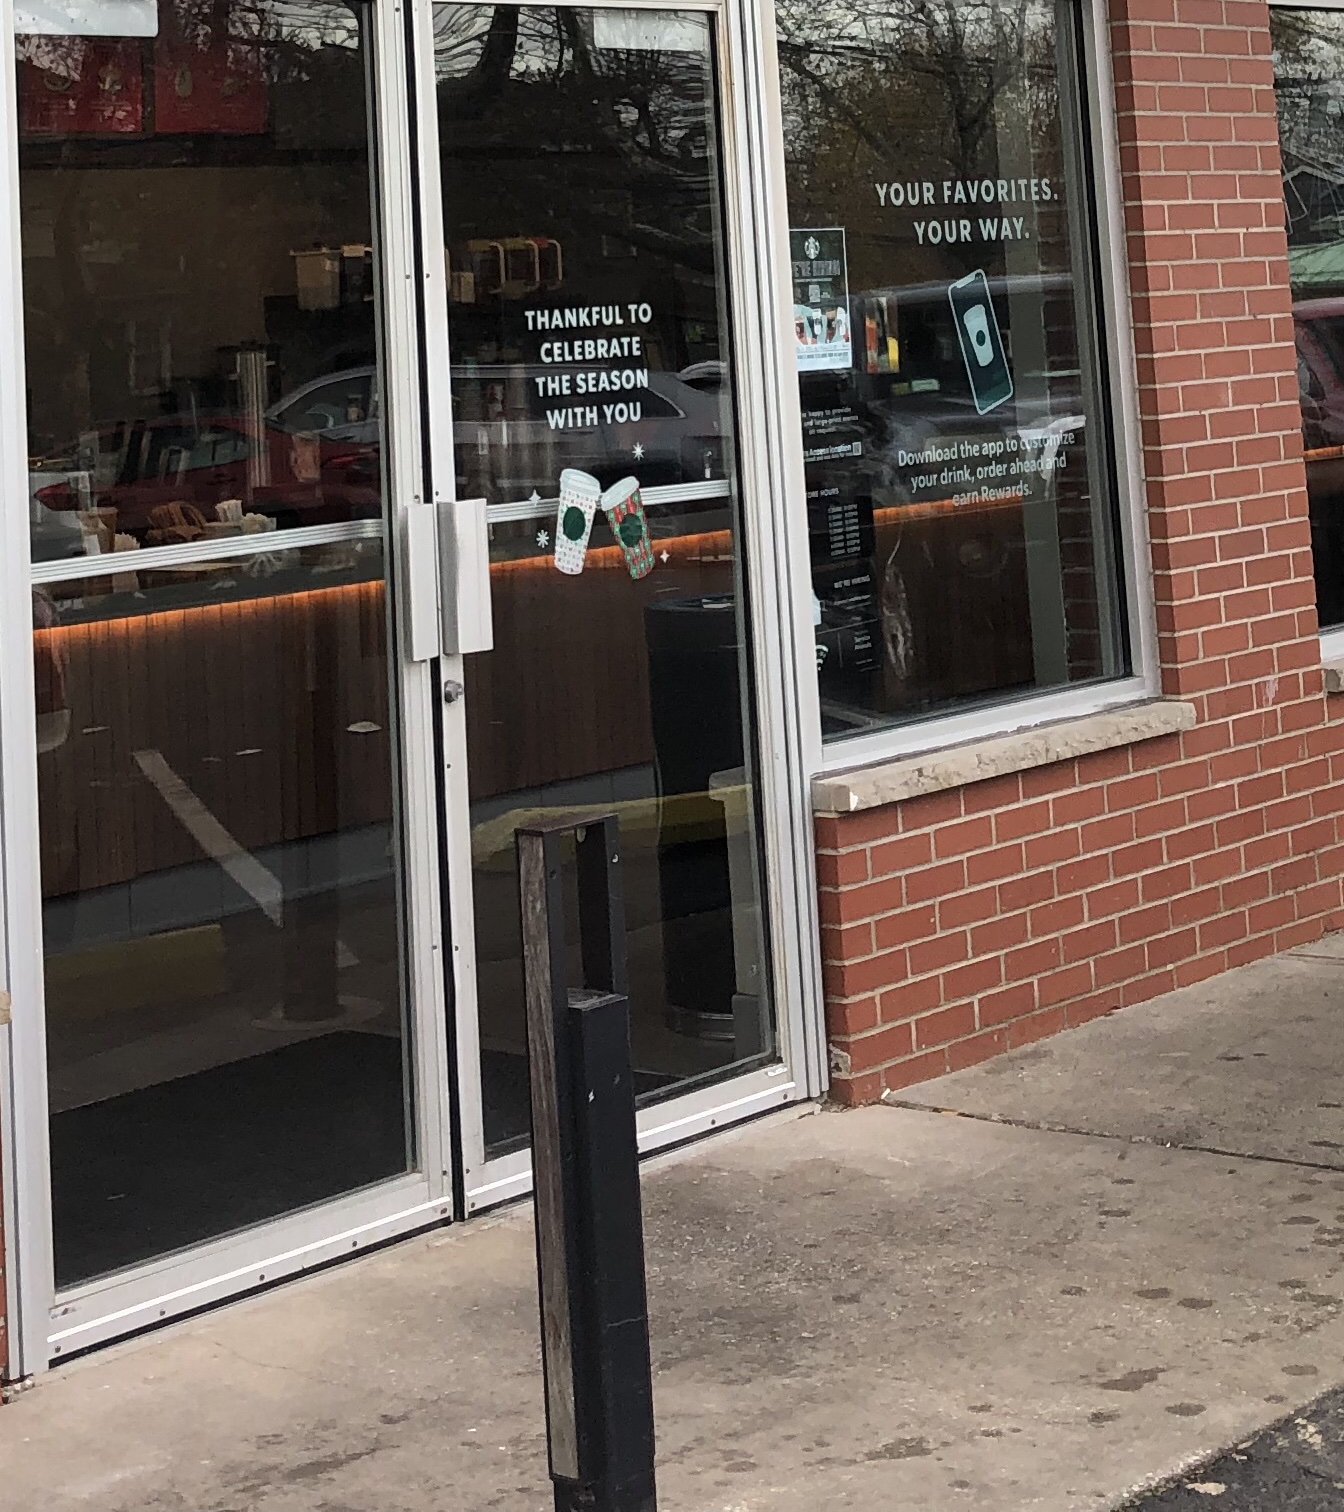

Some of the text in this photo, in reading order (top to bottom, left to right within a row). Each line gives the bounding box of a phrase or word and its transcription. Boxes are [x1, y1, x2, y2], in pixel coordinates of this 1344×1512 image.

[875, 178, 1058, 207] YOUR FAVORITES.
[913, 217, 1030, 245] YOUR WAY.
[524, 303, 652, 331] THANKFUL TO
[540, 336, 641, 363] CELEBRATE
[535, 368, 649, 397] THE SEASON
[546, 402, 641, 430] WITH YOU
[898, 430, 1075, 467] Download the app to customize
[911, 451, 1067, 493] your drink, order ahead and
[952, 480, 1033, 507] earn Rewards.
